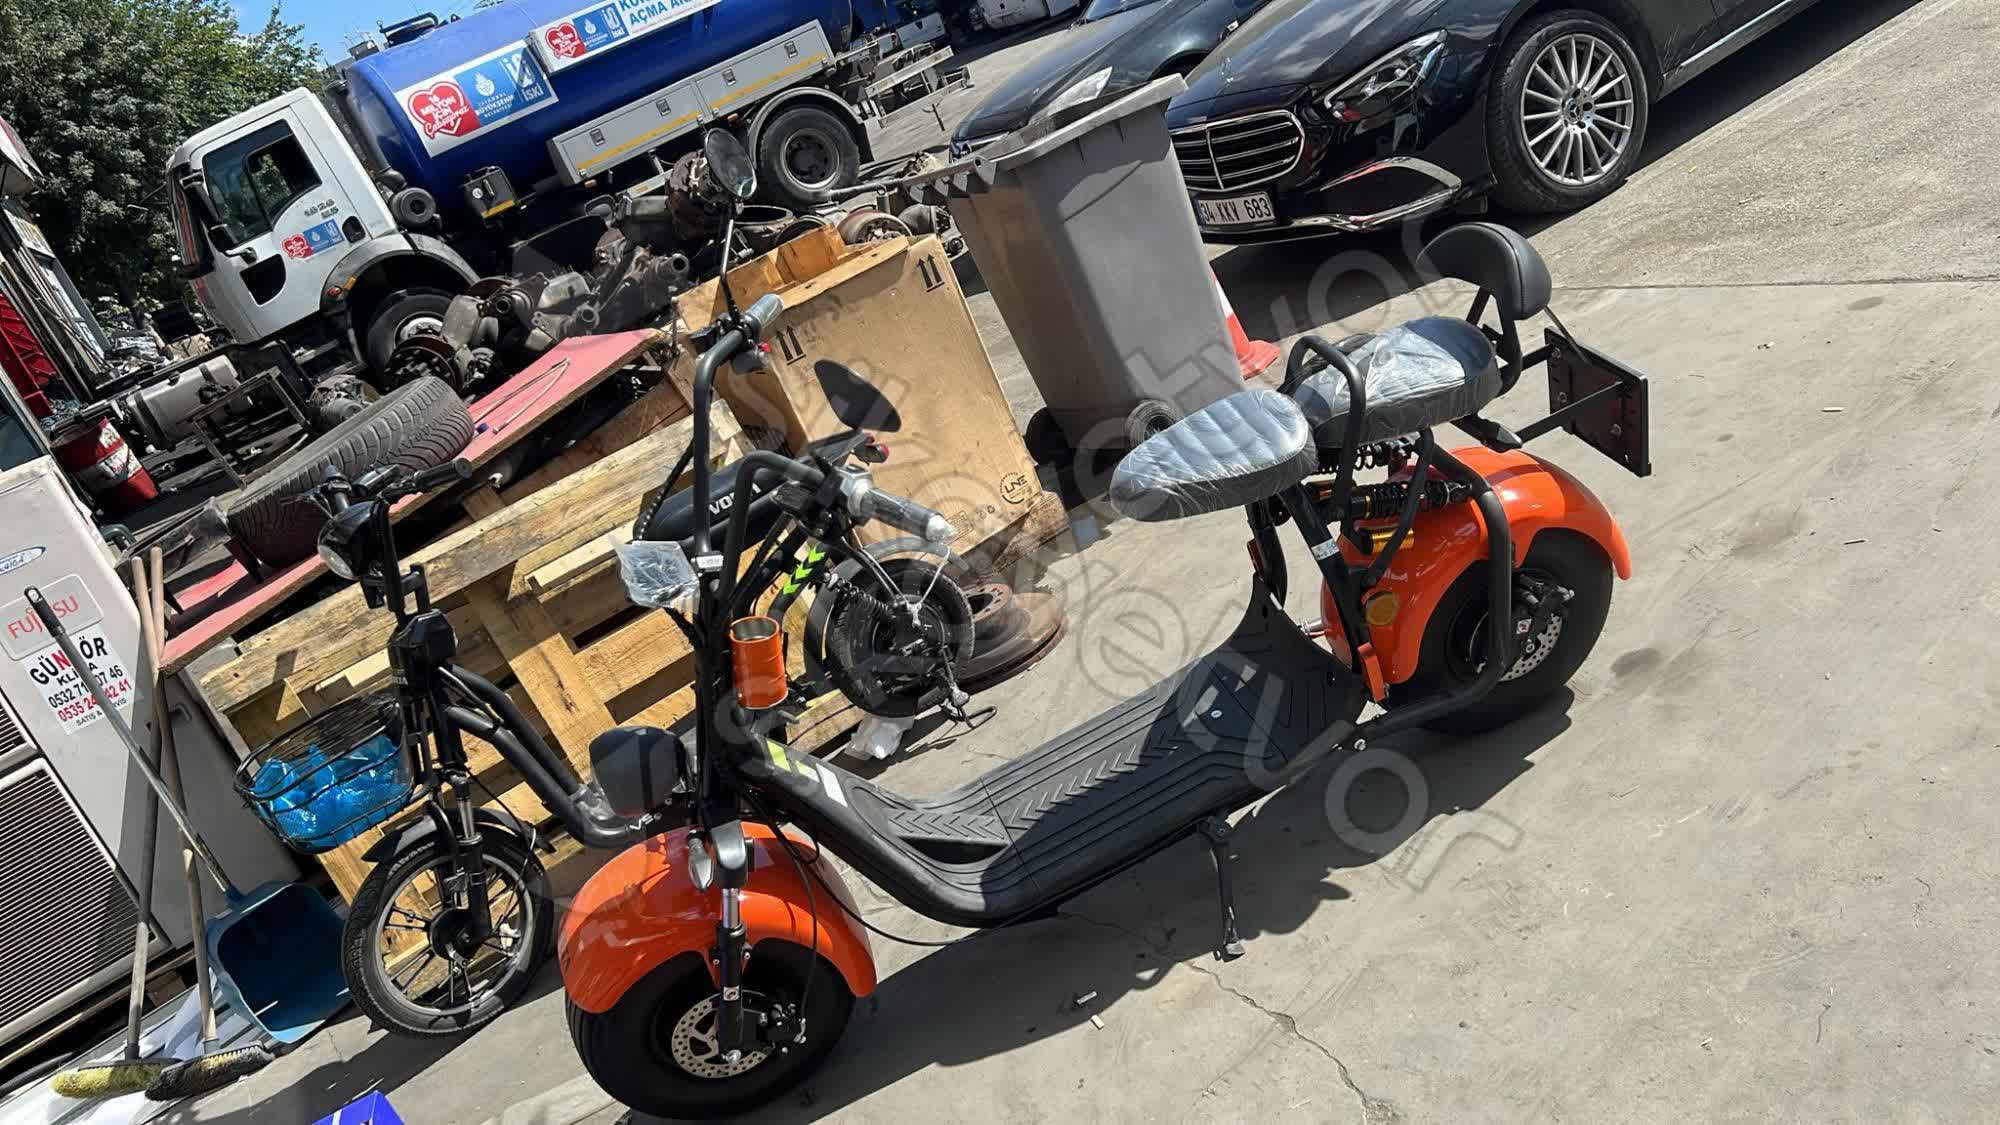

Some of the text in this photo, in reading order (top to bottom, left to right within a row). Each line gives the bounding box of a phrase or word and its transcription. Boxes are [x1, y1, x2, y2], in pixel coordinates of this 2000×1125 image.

[630, 4, 667, 25] AÇMA
[521, 84, 544, 101] İSKİ
[1244, 197, 1271, 219] 683
[30, 636, 108, 685] GÜNÖR
[56, 662, 98, 686] KLİA
[48, 687, 76, 708] 0532
[73, 681, 90, 696] 71
[109, 665, 123, 679] 46
[58, 701, 85, 722] 0535
[83, 694, 99, 709] 24
[119, 678, 132, 692] 41
